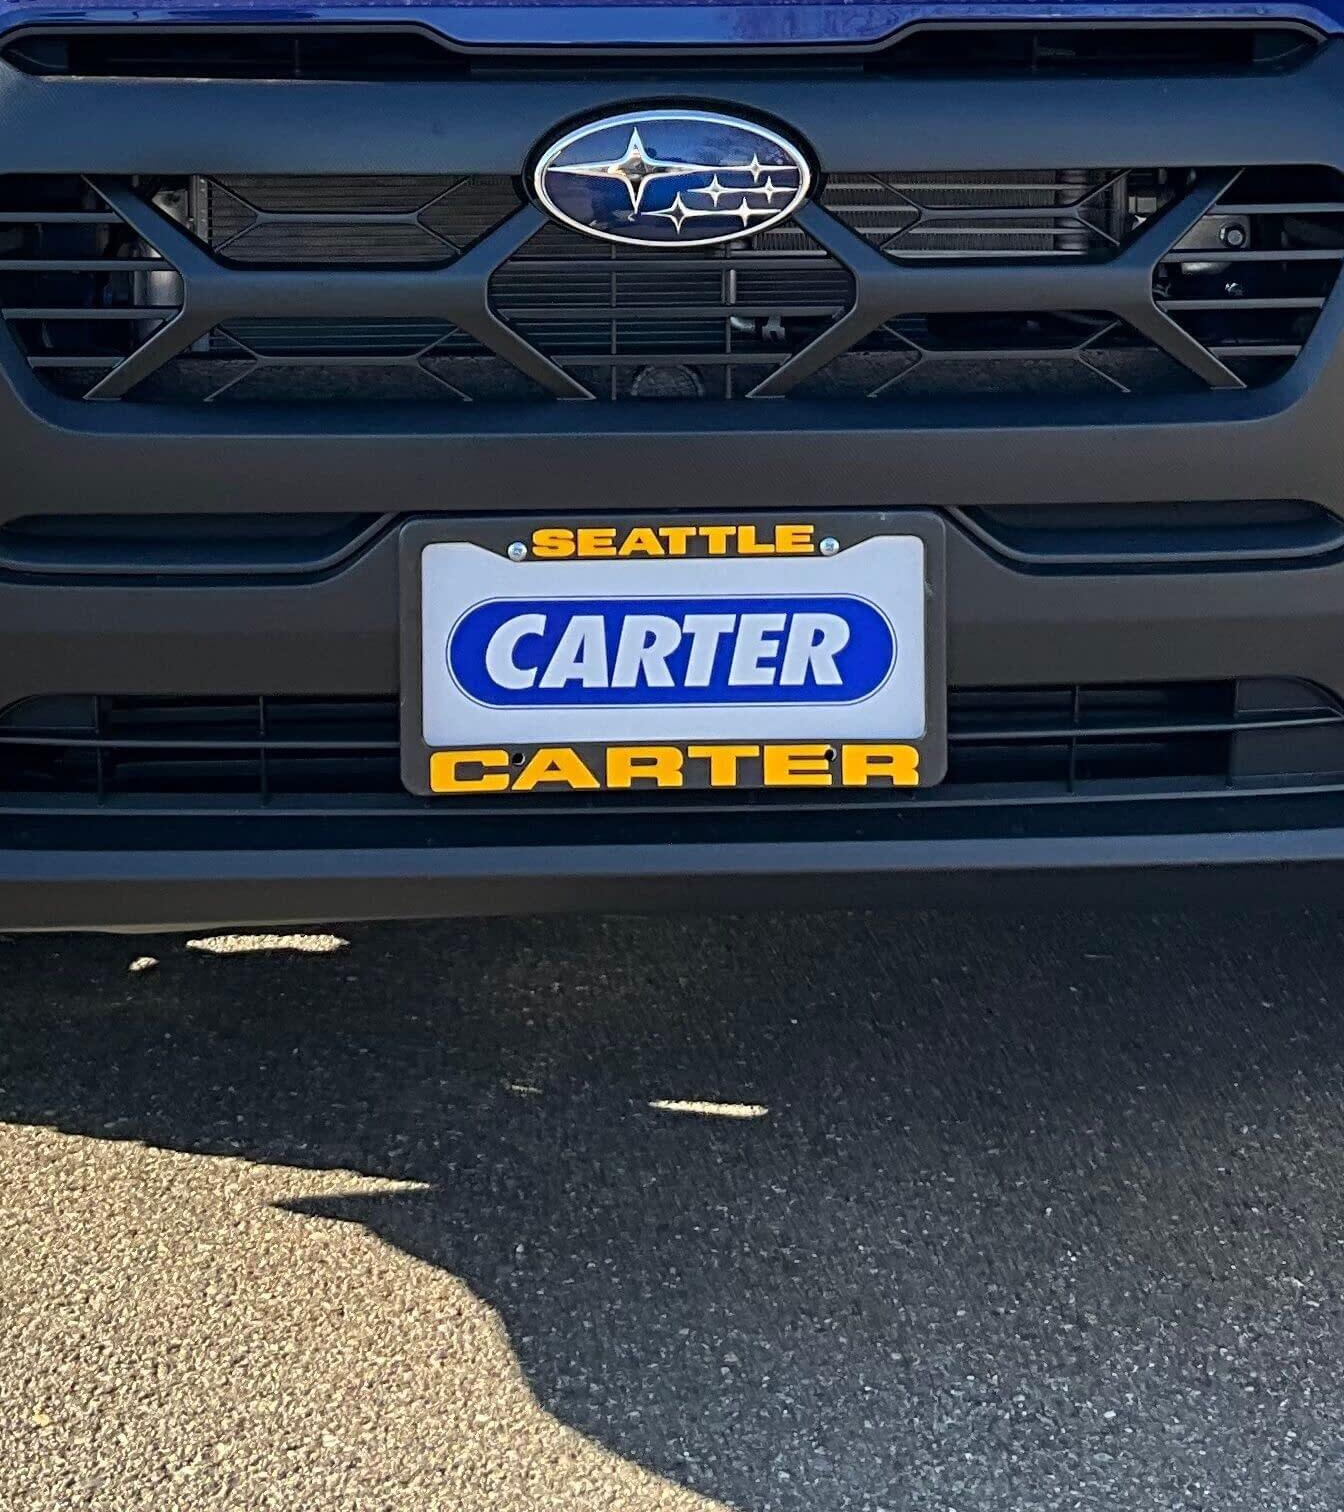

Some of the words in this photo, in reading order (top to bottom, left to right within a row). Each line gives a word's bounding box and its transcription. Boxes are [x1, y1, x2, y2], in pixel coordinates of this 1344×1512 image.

[532, 524, 814, 557] SEATTLE
[485, 613, 850, 689] CARTER
[429, 744, 919, 793] CARTER
